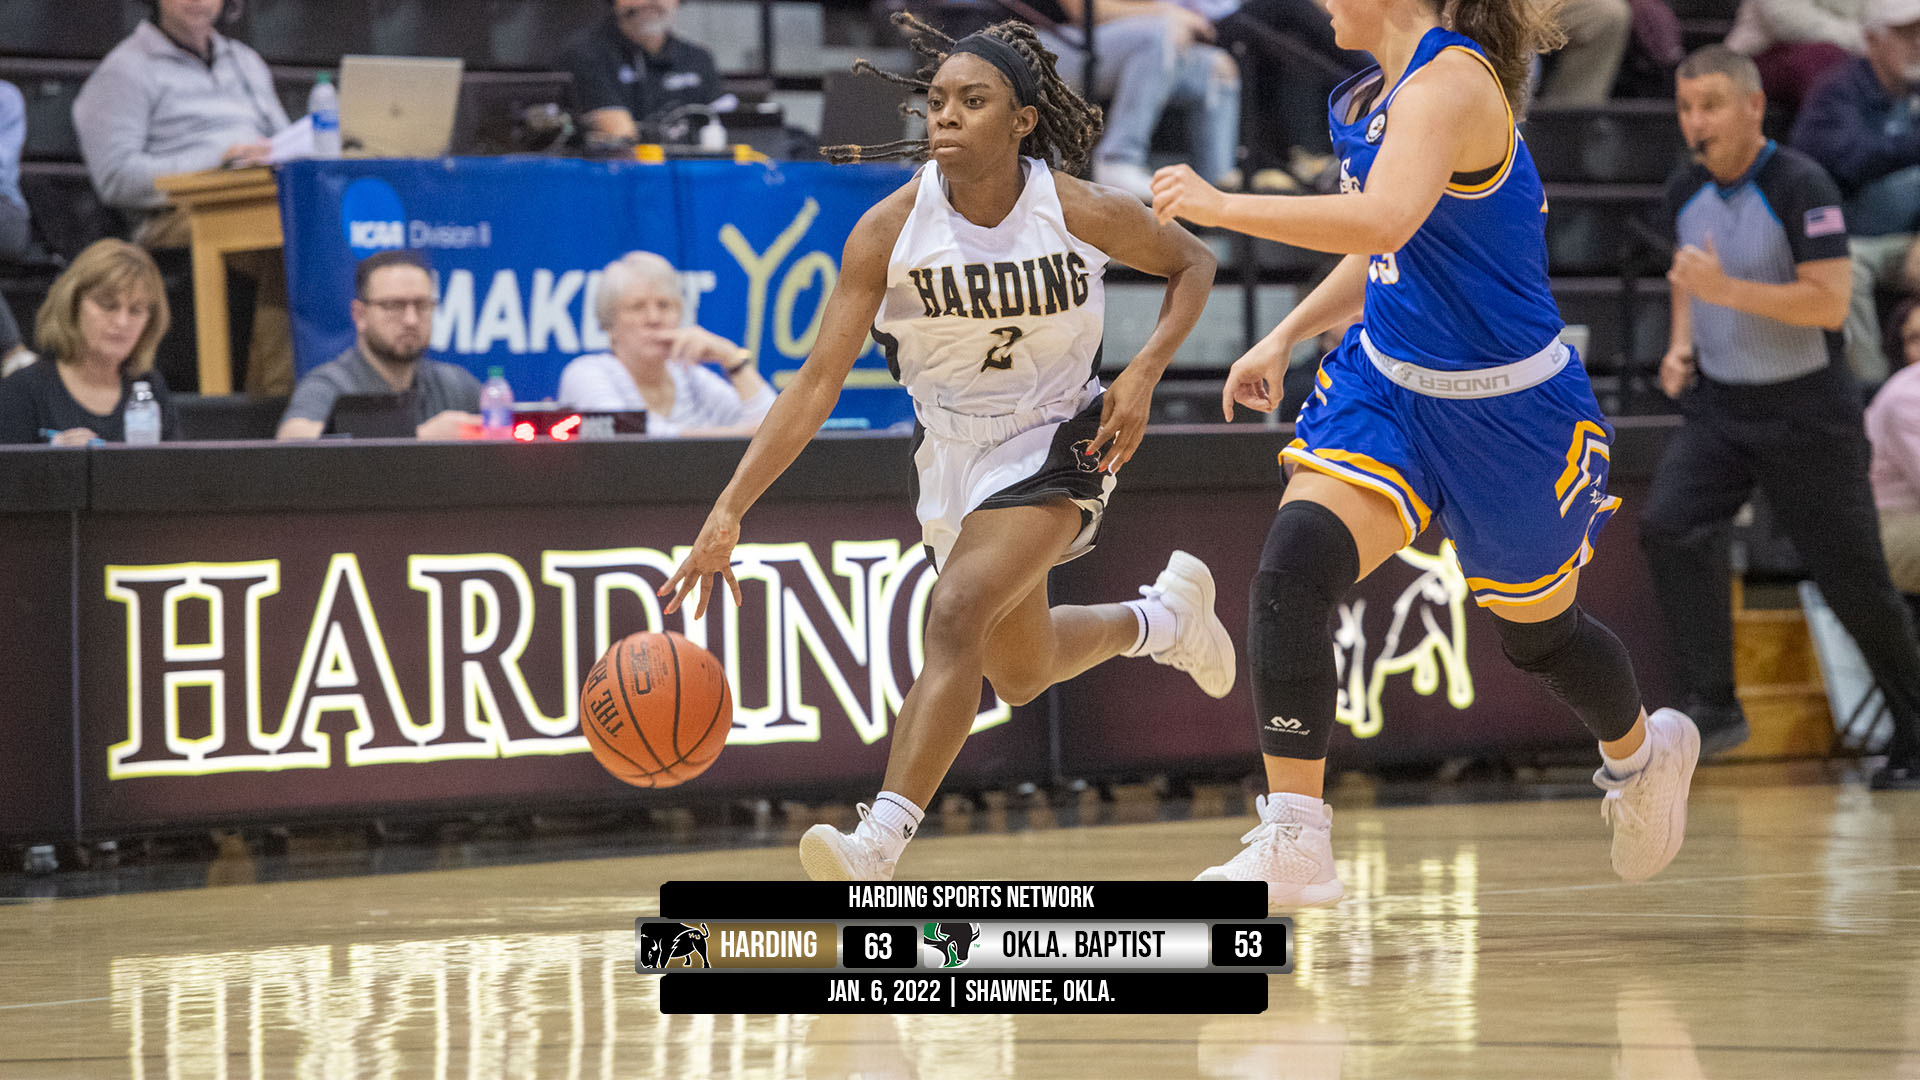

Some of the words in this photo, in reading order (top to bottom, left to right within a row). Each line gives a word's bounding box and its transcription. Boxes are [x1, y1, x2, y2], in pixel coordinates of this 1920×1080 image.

[908, 251, 1090, 319] HARDING
[980, 325, 1024, 373] 2
[1419, 373, 1511, 392] UNDER
[590, 688, 625, 738] THE
